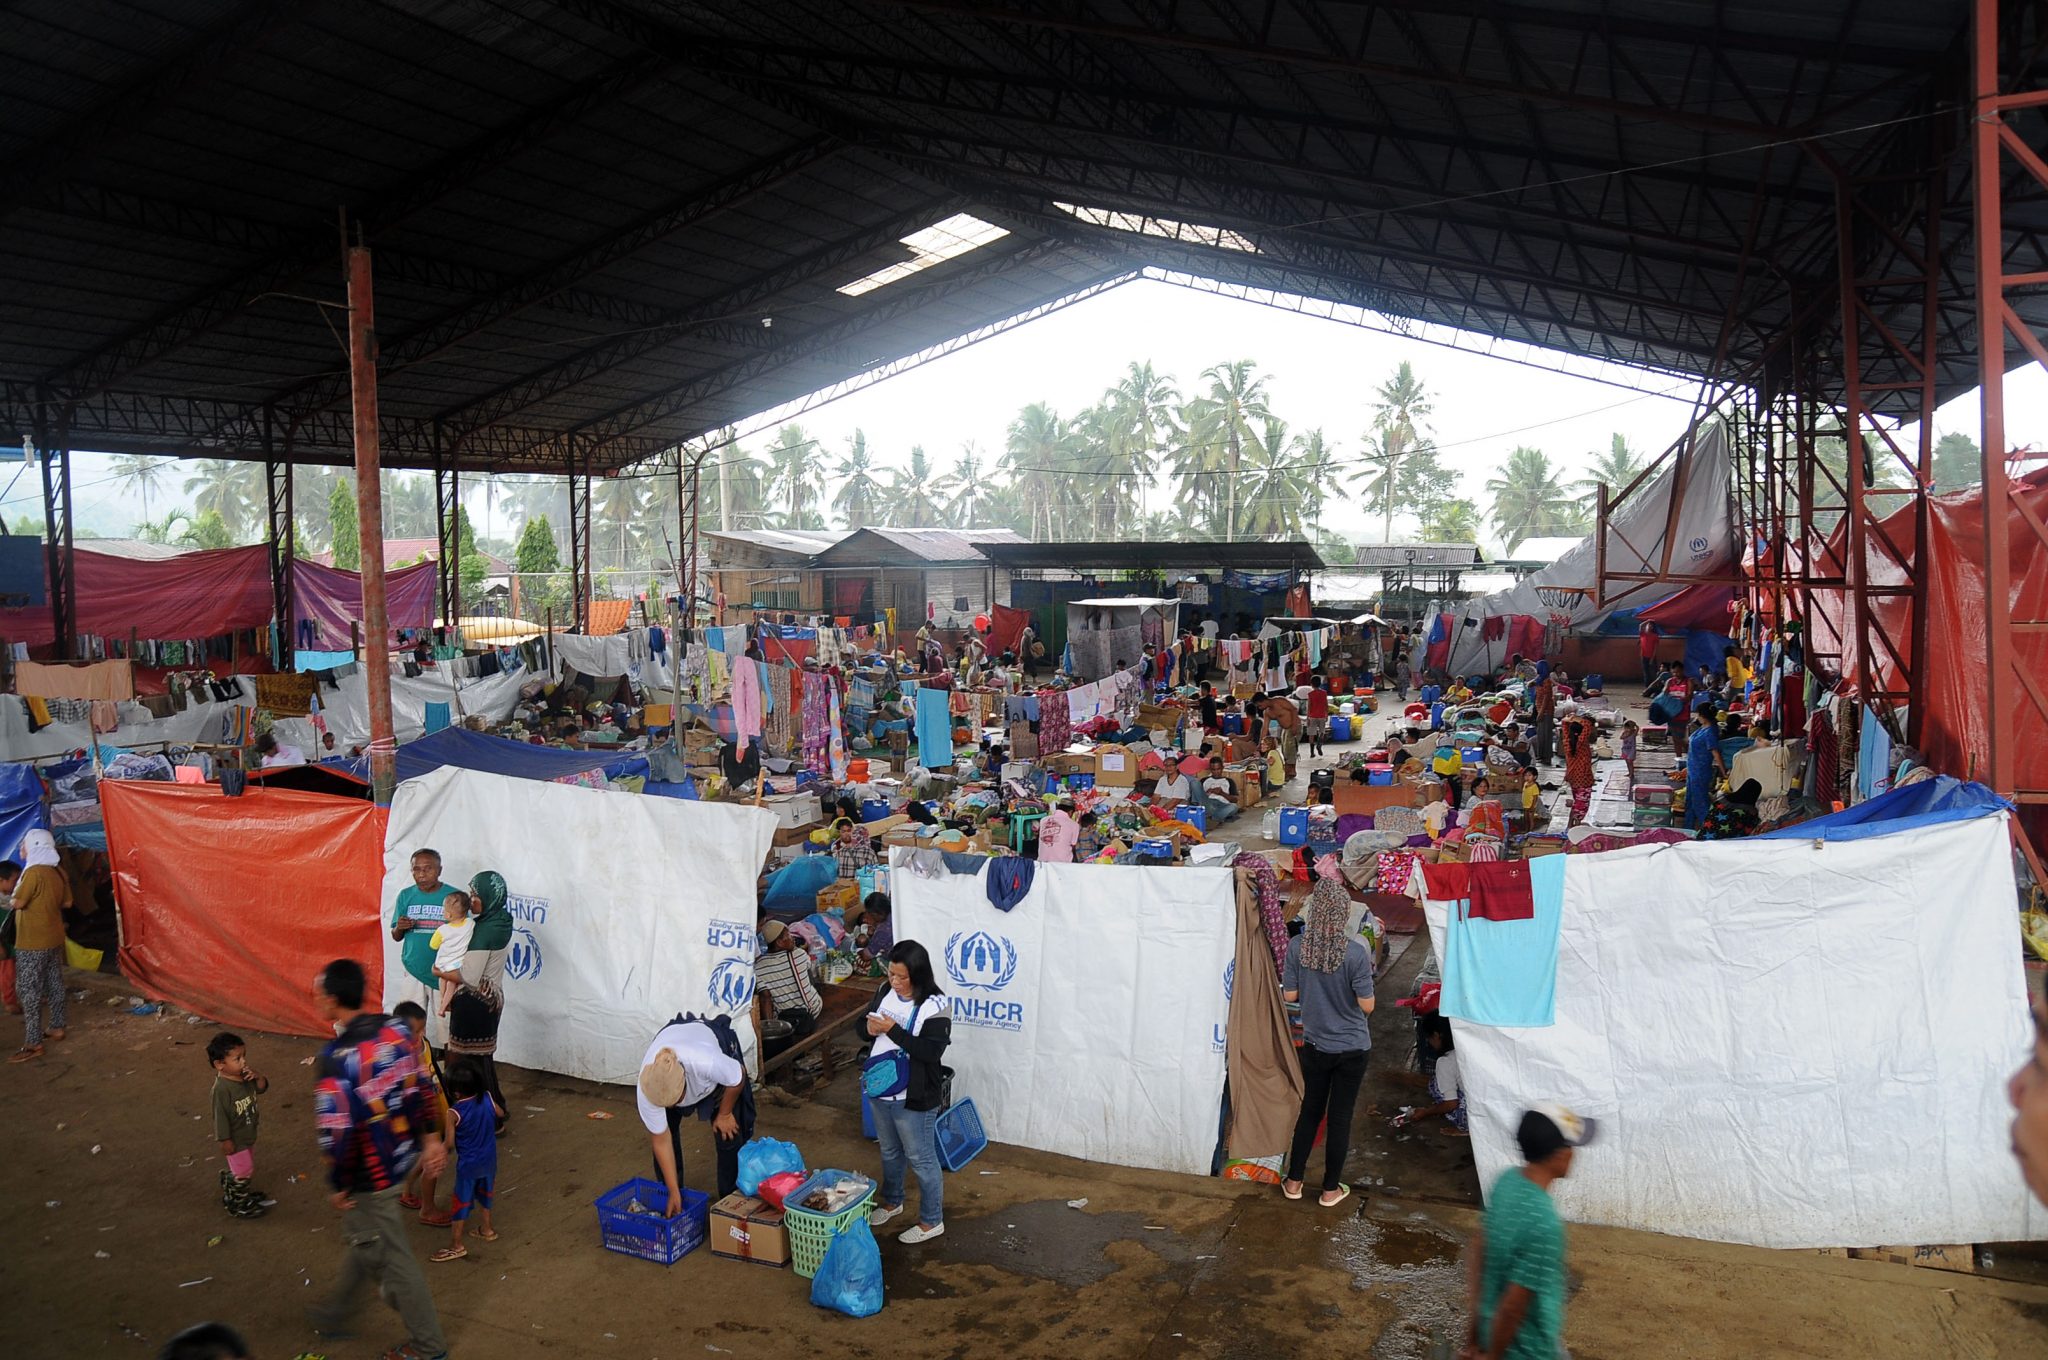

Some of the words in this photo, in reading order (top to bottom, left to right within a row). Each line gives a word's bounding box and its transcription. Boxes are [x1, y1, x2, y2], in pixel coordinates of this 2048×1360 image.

[505, 900, 547, 925] UNH
[707, 928, 754, 952] HCR
[964, 1016, 993, 1026] Refugee
[995, 1019, 1022, 1032] Agency
